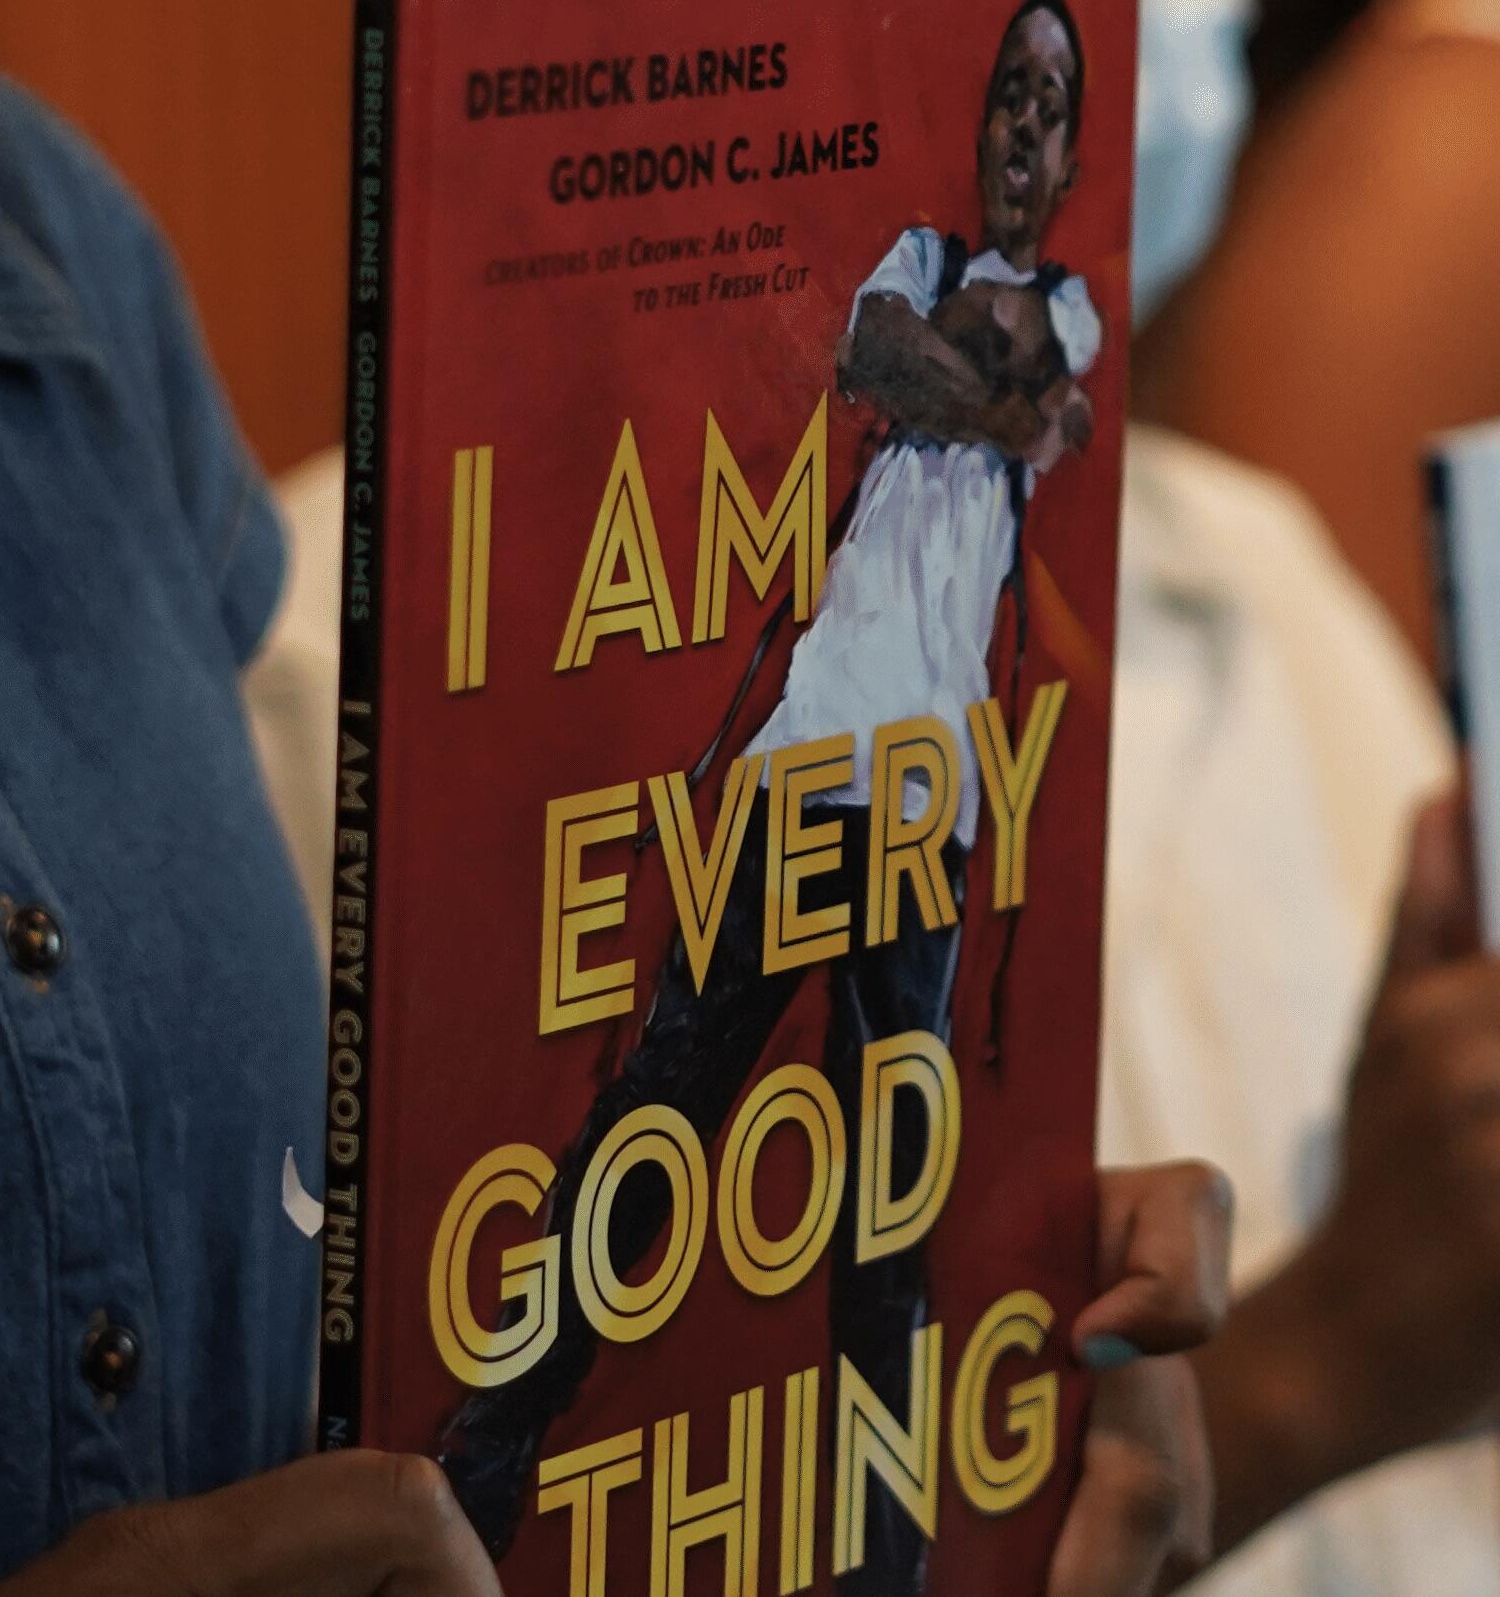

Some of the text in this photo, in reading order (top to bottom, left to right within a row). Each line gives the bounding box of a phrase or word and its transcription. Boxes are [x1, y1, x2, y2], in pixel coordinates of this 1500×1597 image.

[362, 26, 384, 167] DERRICK
[466, 42, 788, 120] DERRICK BARNES
[548, 121, 879, 205] GORDON C. JAMES
[360, 176, 381, 303] BARNES
[354, 330, 377, 471] GORDON
[350, 520, 372, 621] JAMES
[445, 388, 830, 694] I AM
[339, 730, 371, 811] AM
[342, 700, 372, 716] I
[334, 827, 369, 994] EVERY
[538, 677, 1070, 1038] EVERY
[329, 1008, 363, 1166] GOOD
[323, 1183, 358, 1344] THING
[427, 1027, 965, 1390] GOOD
[536, 1289, 1061, 1597] THING
